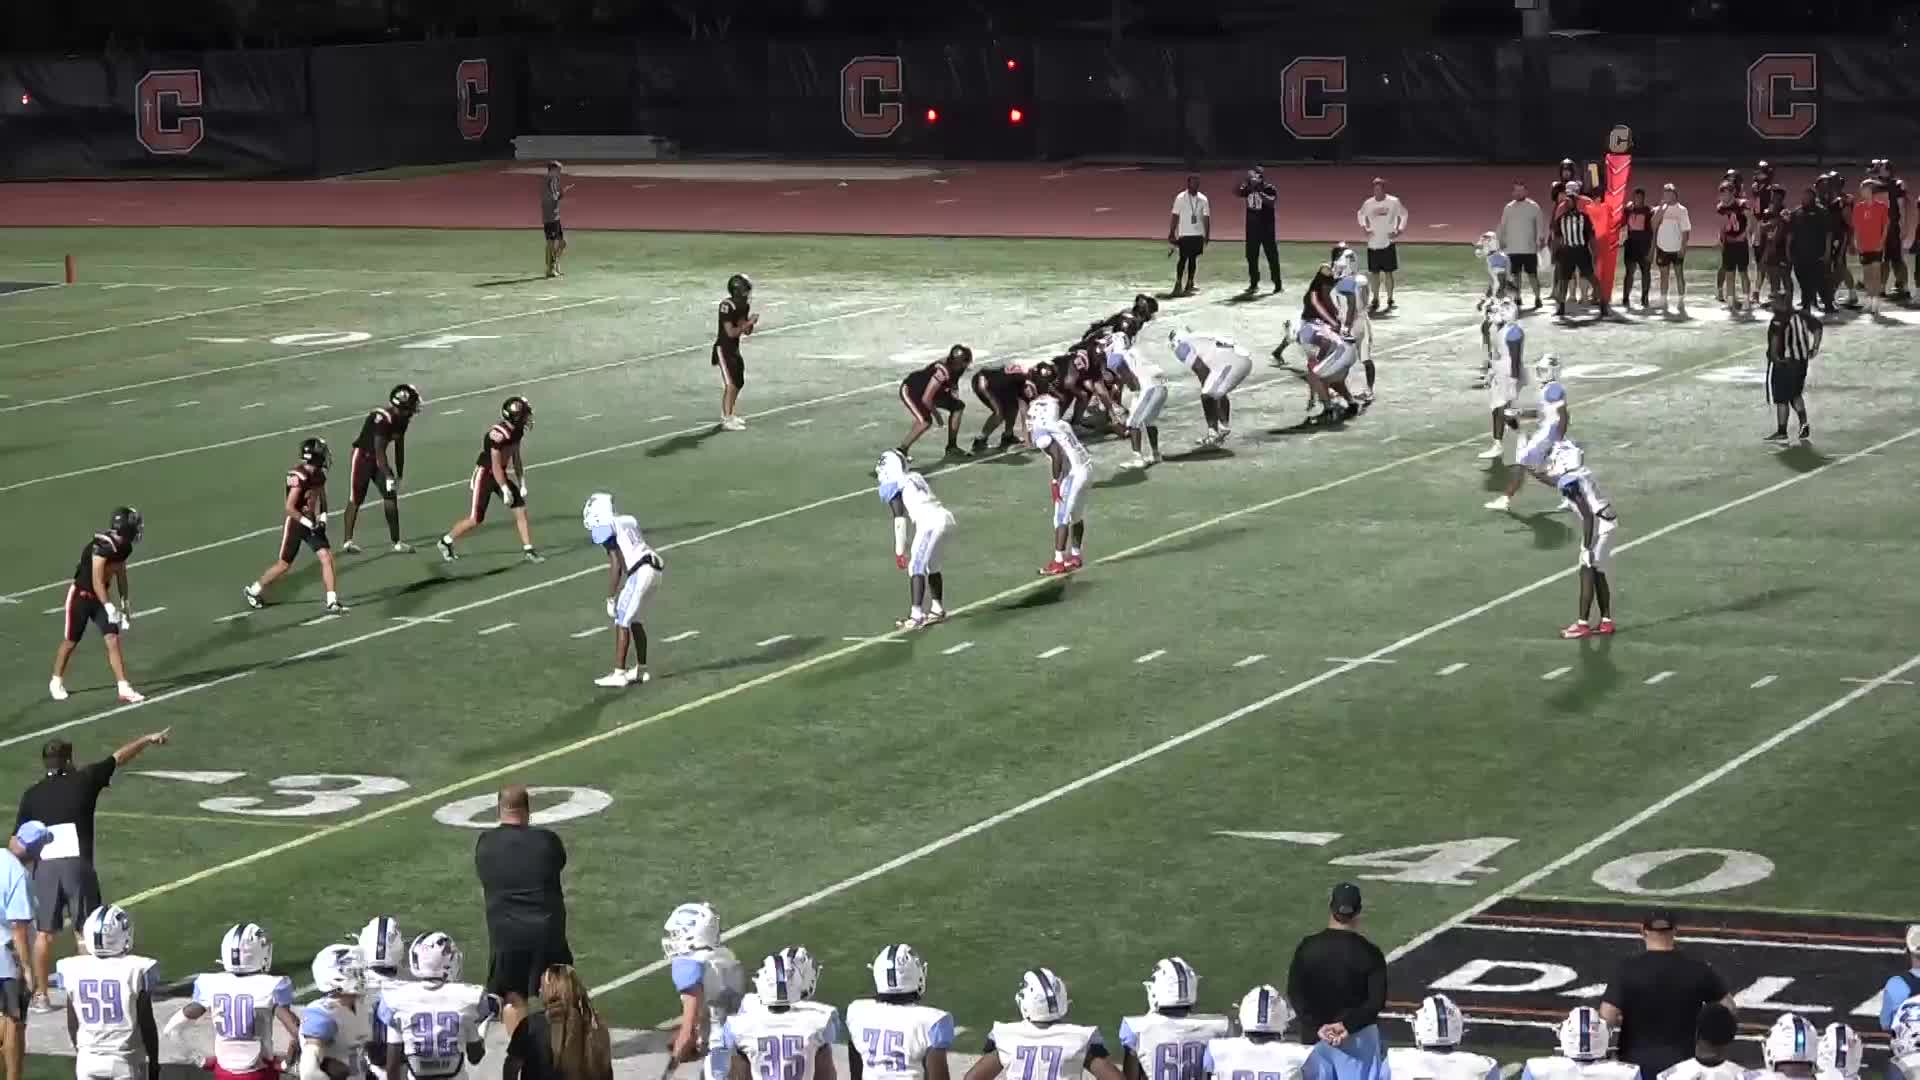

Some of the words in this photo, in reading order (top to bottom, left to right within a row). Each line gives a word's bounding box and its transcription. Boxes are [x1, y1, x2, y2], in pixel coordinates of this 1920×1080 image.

[136, 69, 203, 154] C
[457, 59, 488, 140] C
[841, 56, 903, 138] C
[1281, 56, 1348, 139] C
[1747, 53, 1817, 140] C
[79, 979, 123, 1023] 59
[213, 993, 255, 1039] 30
[410, 1011, 459, 1057] 92
[757, 1034, 804, 1080] 35
[1016, 1046, 1064, 1080] 77
